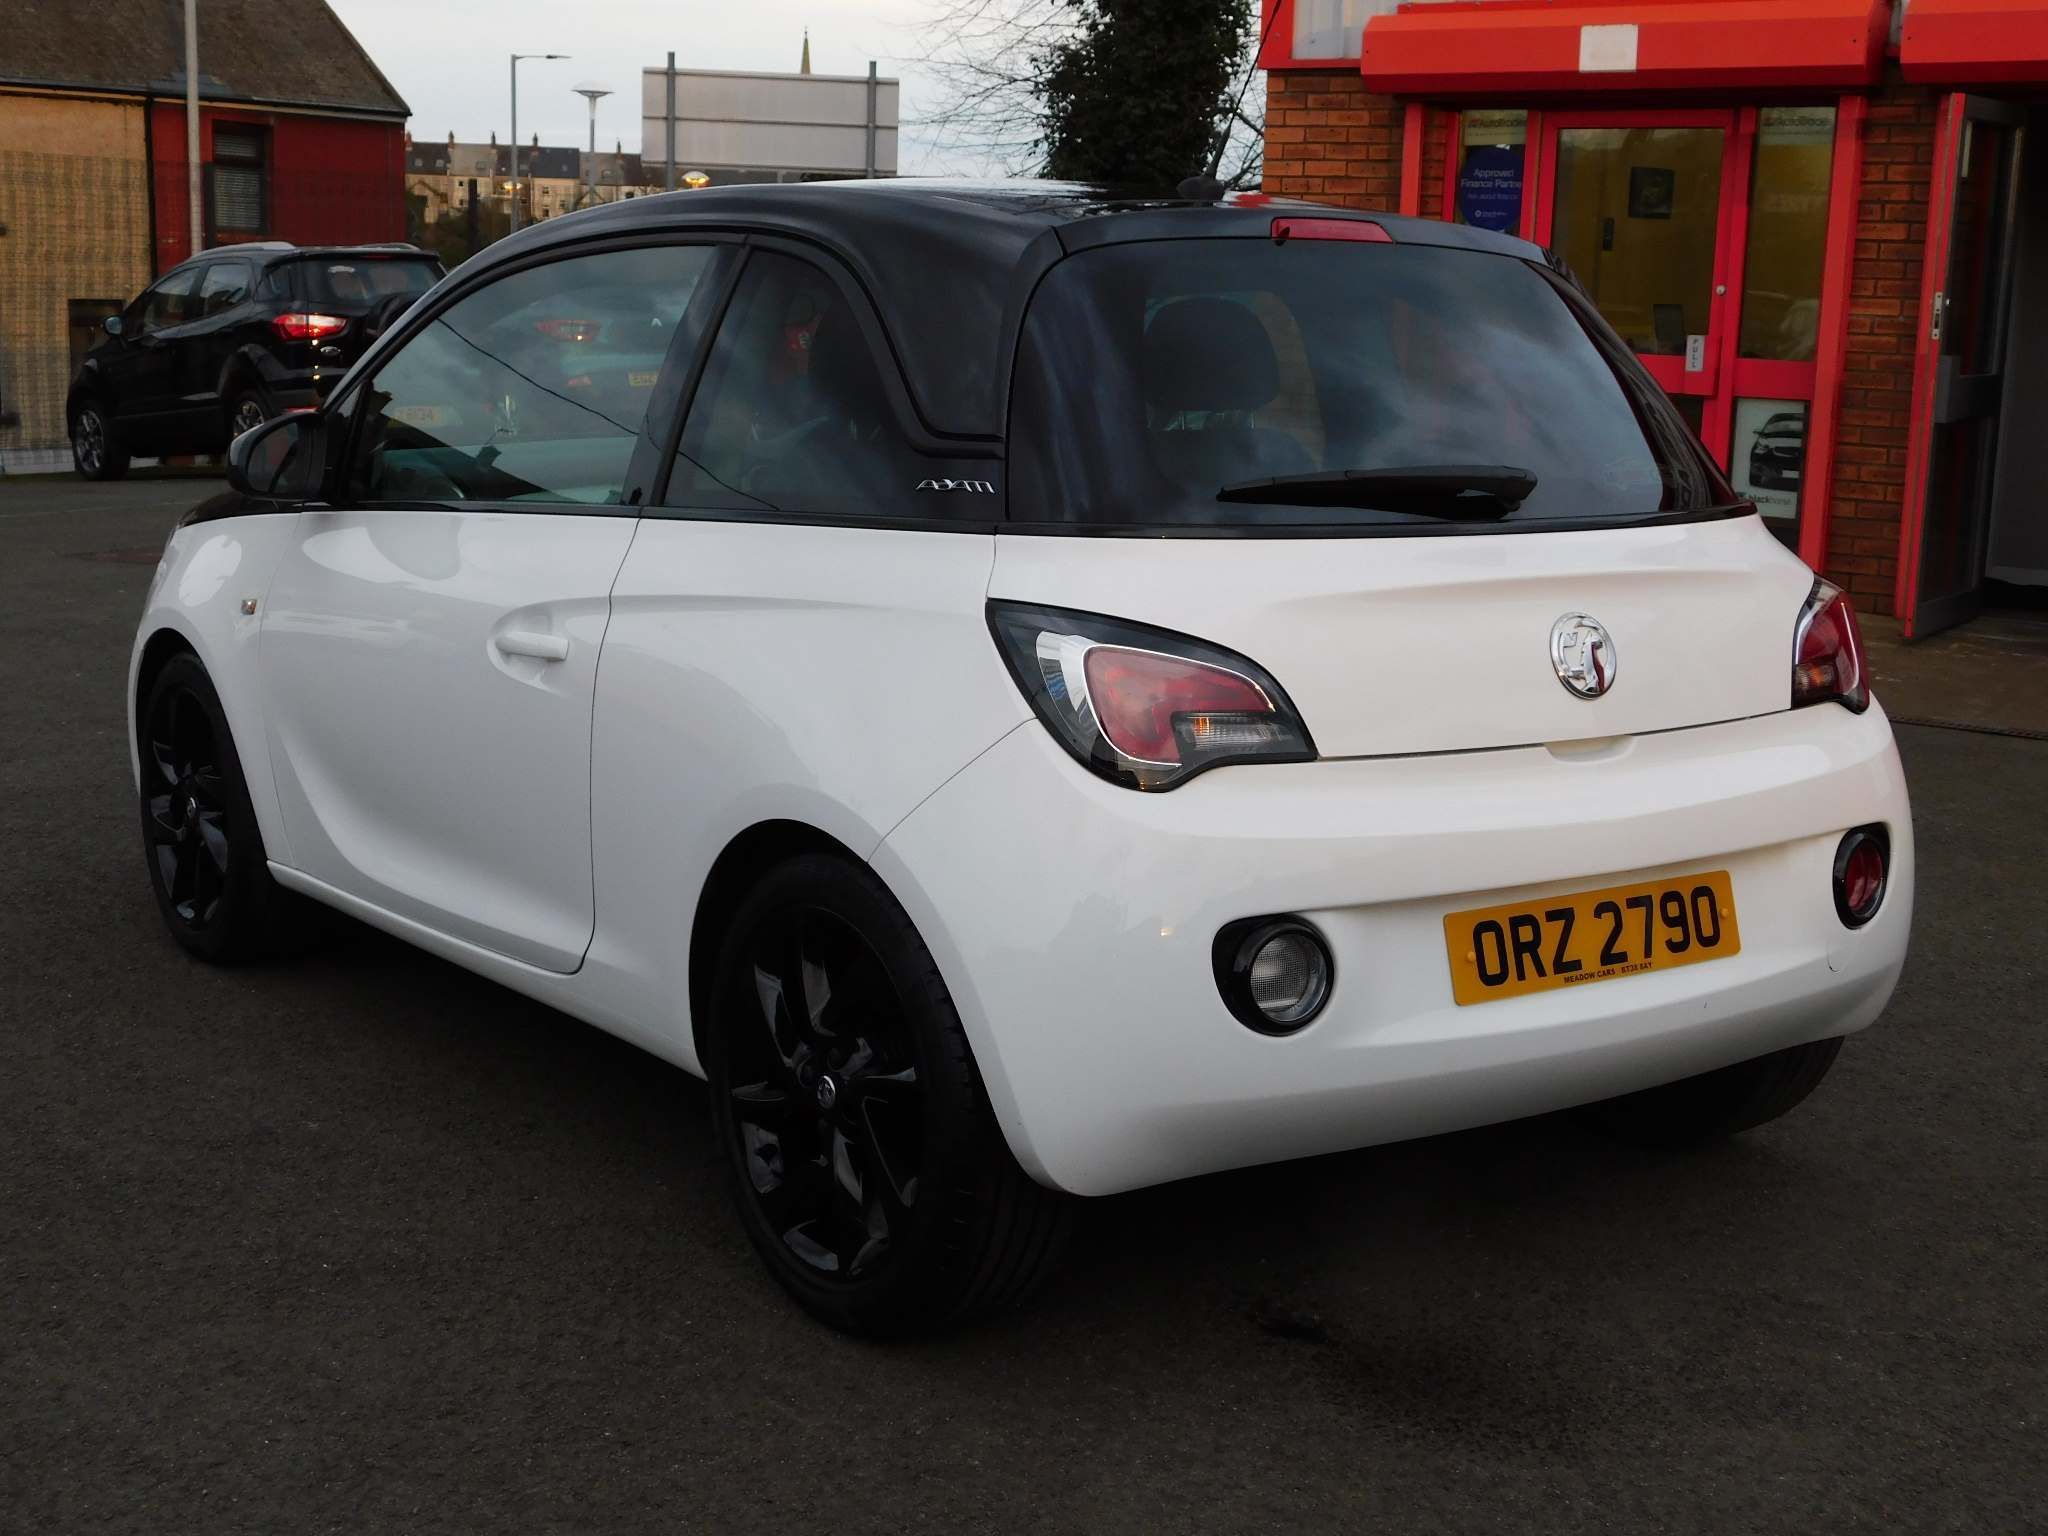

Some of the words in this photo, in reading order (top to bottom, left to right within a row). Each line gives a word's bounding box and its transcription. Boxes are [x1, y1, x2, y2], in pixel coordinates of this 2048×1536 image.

[1473, 168, 1514, 178] Approved
[1461, 179, 1493, 188] Finance
[1472, 906, 1583, 987] ORZ
[1593, 885, 1721, 967] 2790
[1563, 972, 1595, 984] MEADOW
[1597, 968, 1616, 978] CARS
